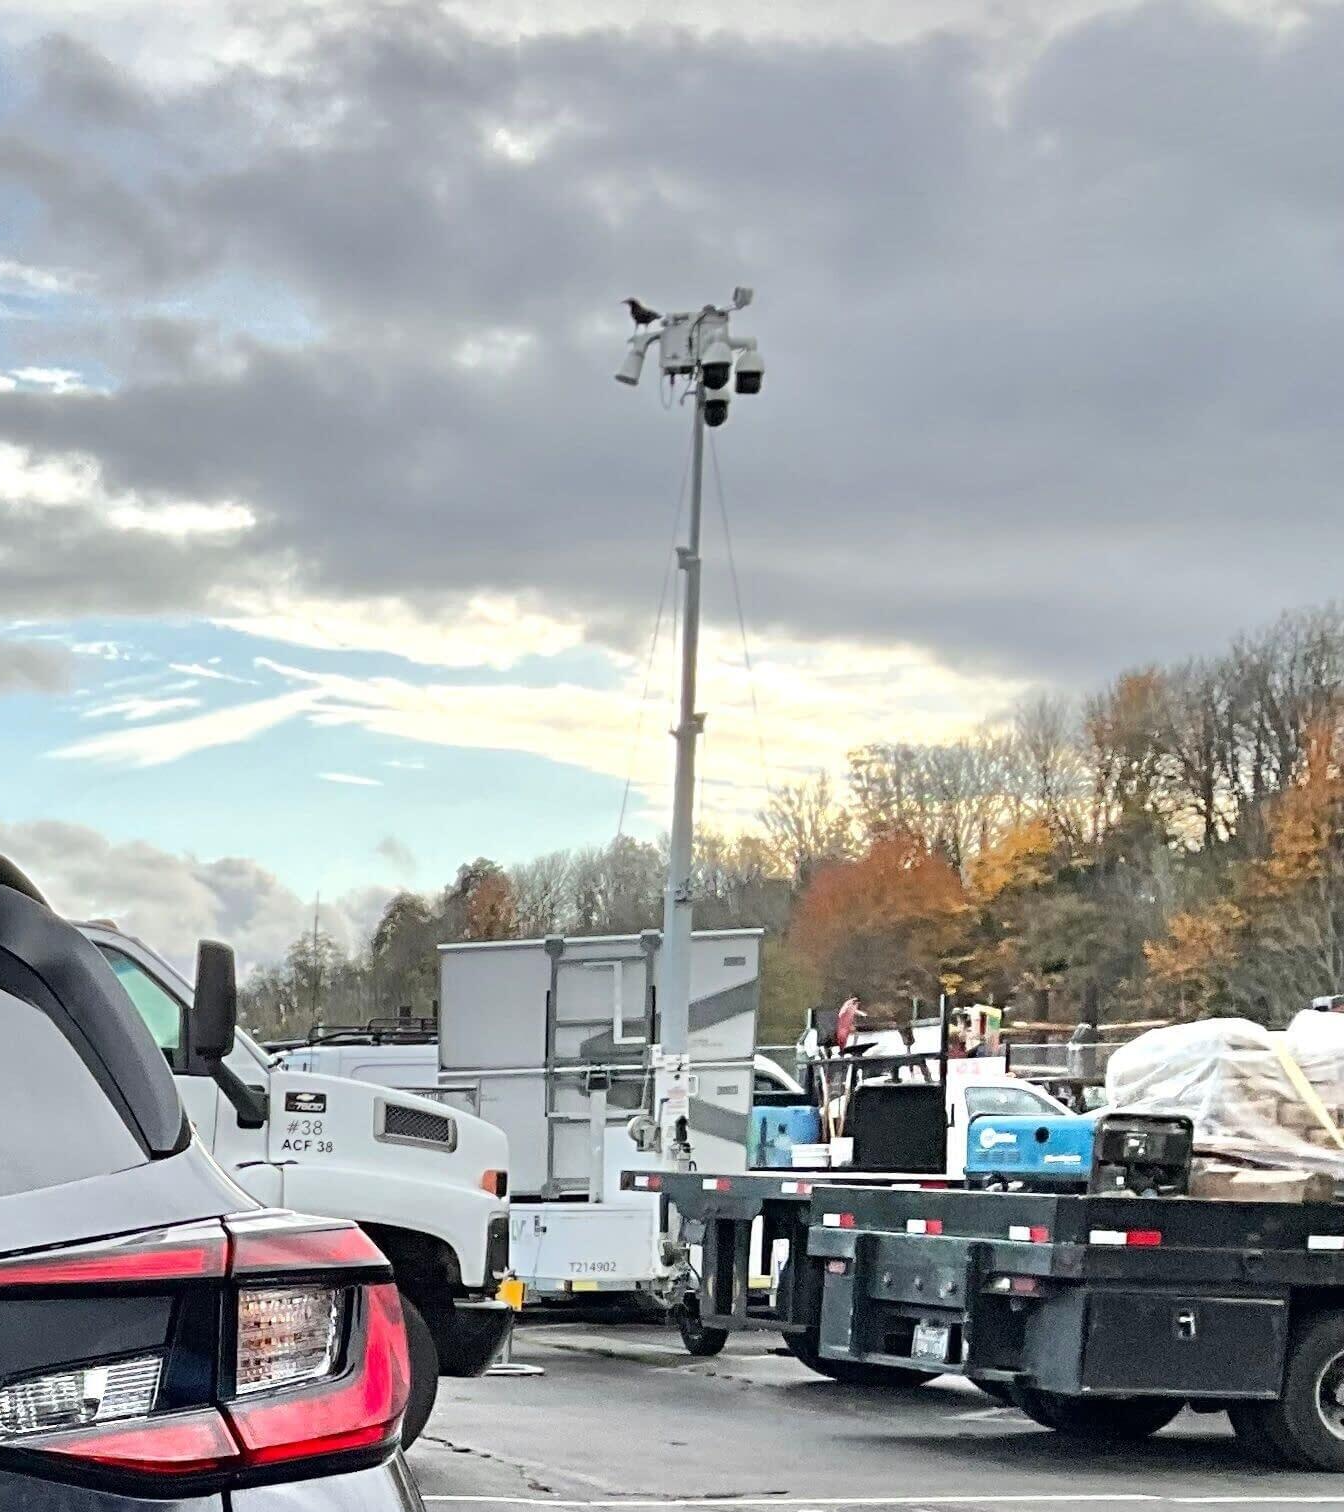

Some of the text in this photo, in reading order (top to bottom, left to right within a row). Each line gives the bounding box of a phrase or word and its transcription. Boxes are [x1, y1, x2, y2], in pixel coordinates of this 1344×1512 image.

[287, 1119, 323, 1136] #38
[281, 1139, 333, 1153] ACF 38
[569, 1261, 617, 1273] T214902
